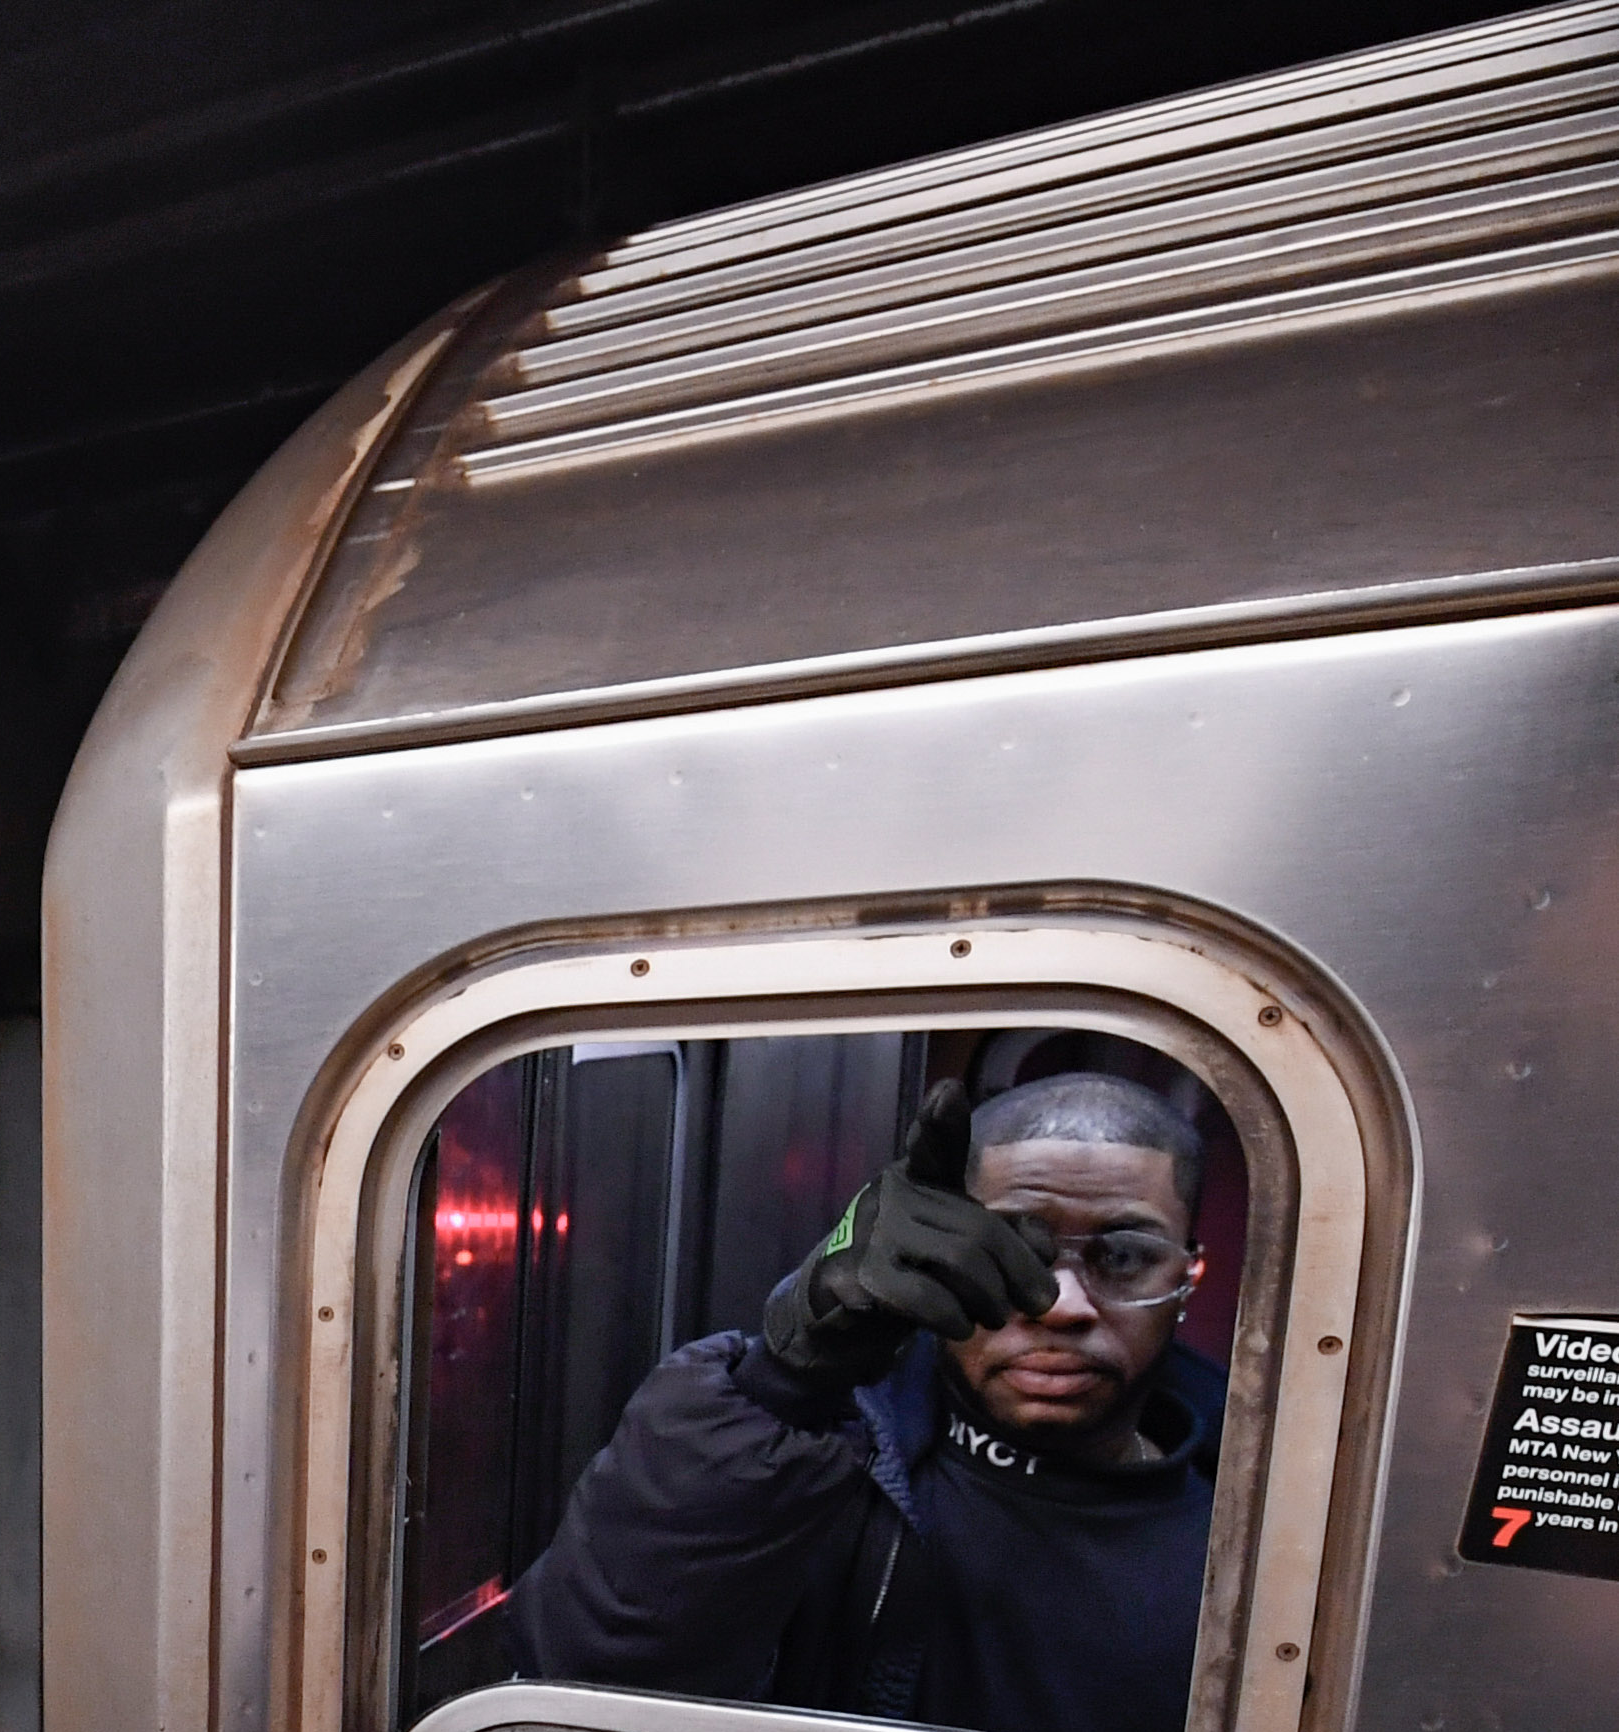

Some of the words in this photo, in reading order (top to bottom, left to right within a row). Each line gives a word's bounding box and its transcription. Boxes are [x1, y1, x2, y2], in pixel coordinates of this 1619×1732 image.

[1522, 1384, 1569, 1404] may
[1571, 1386, 1600, 1404] be
[1509, 1438, 1558, 1458] MTA
[1561, 1443, 1612, 1464] New
[1502, 1464, 1610, 1488] personnel
[1497, 1485, 1614, 1510] punishable
[1491, 1506, 1532, 1548] 7
[1535, 1511, 1595, 1530] years
[1597, 1516, 1619, 1534] in
